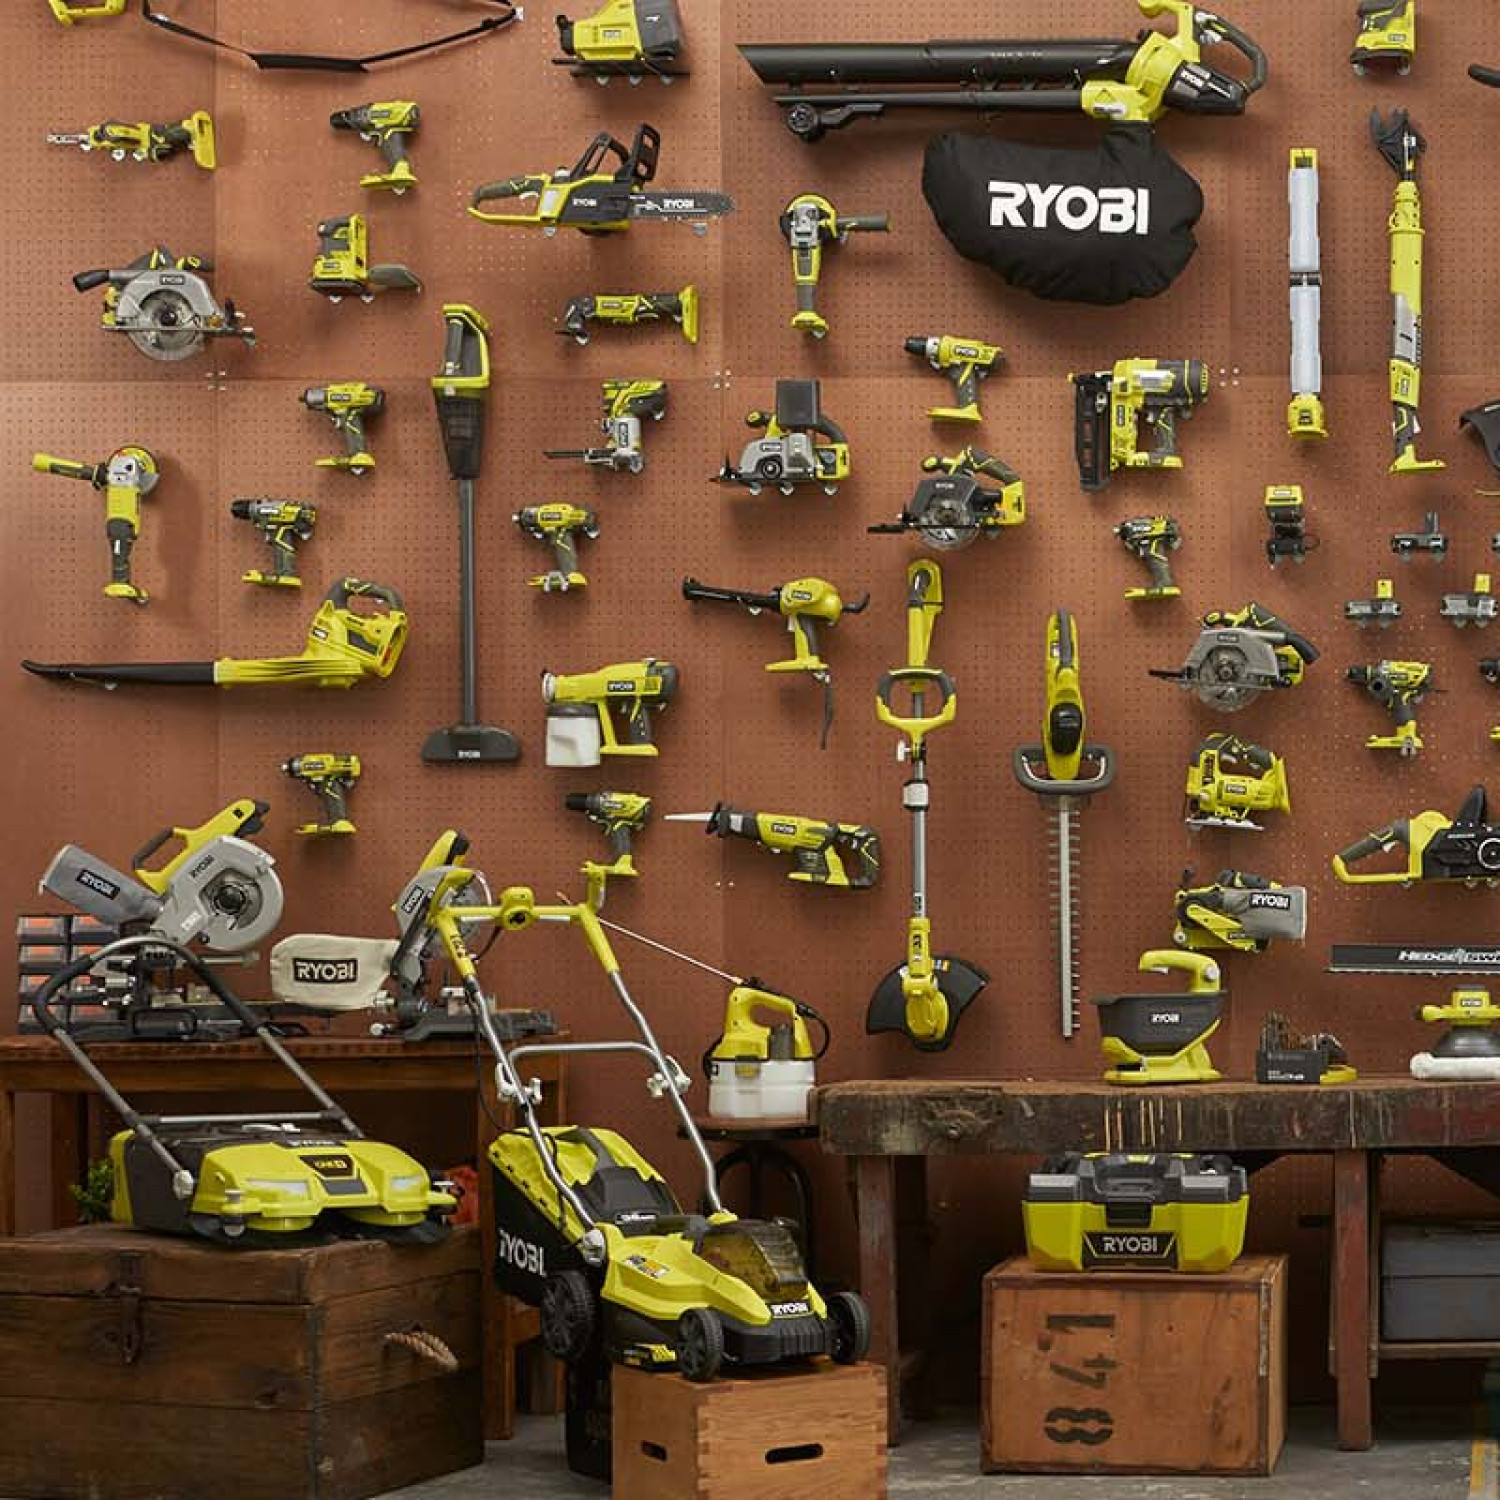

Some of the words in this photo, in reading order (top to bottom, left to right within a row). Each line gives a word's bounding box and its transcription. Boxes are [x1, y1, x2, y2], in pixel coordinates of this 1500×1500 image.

[988, 181, 1149, 235] RYOBI
[1251, 893, 1289, 908] RYOBI
[296, 961, 355, 980] RYOBI
[1103, 1236, 1157, 1253] RYOBI
[1043, 1313, 1119, 1446] 841
